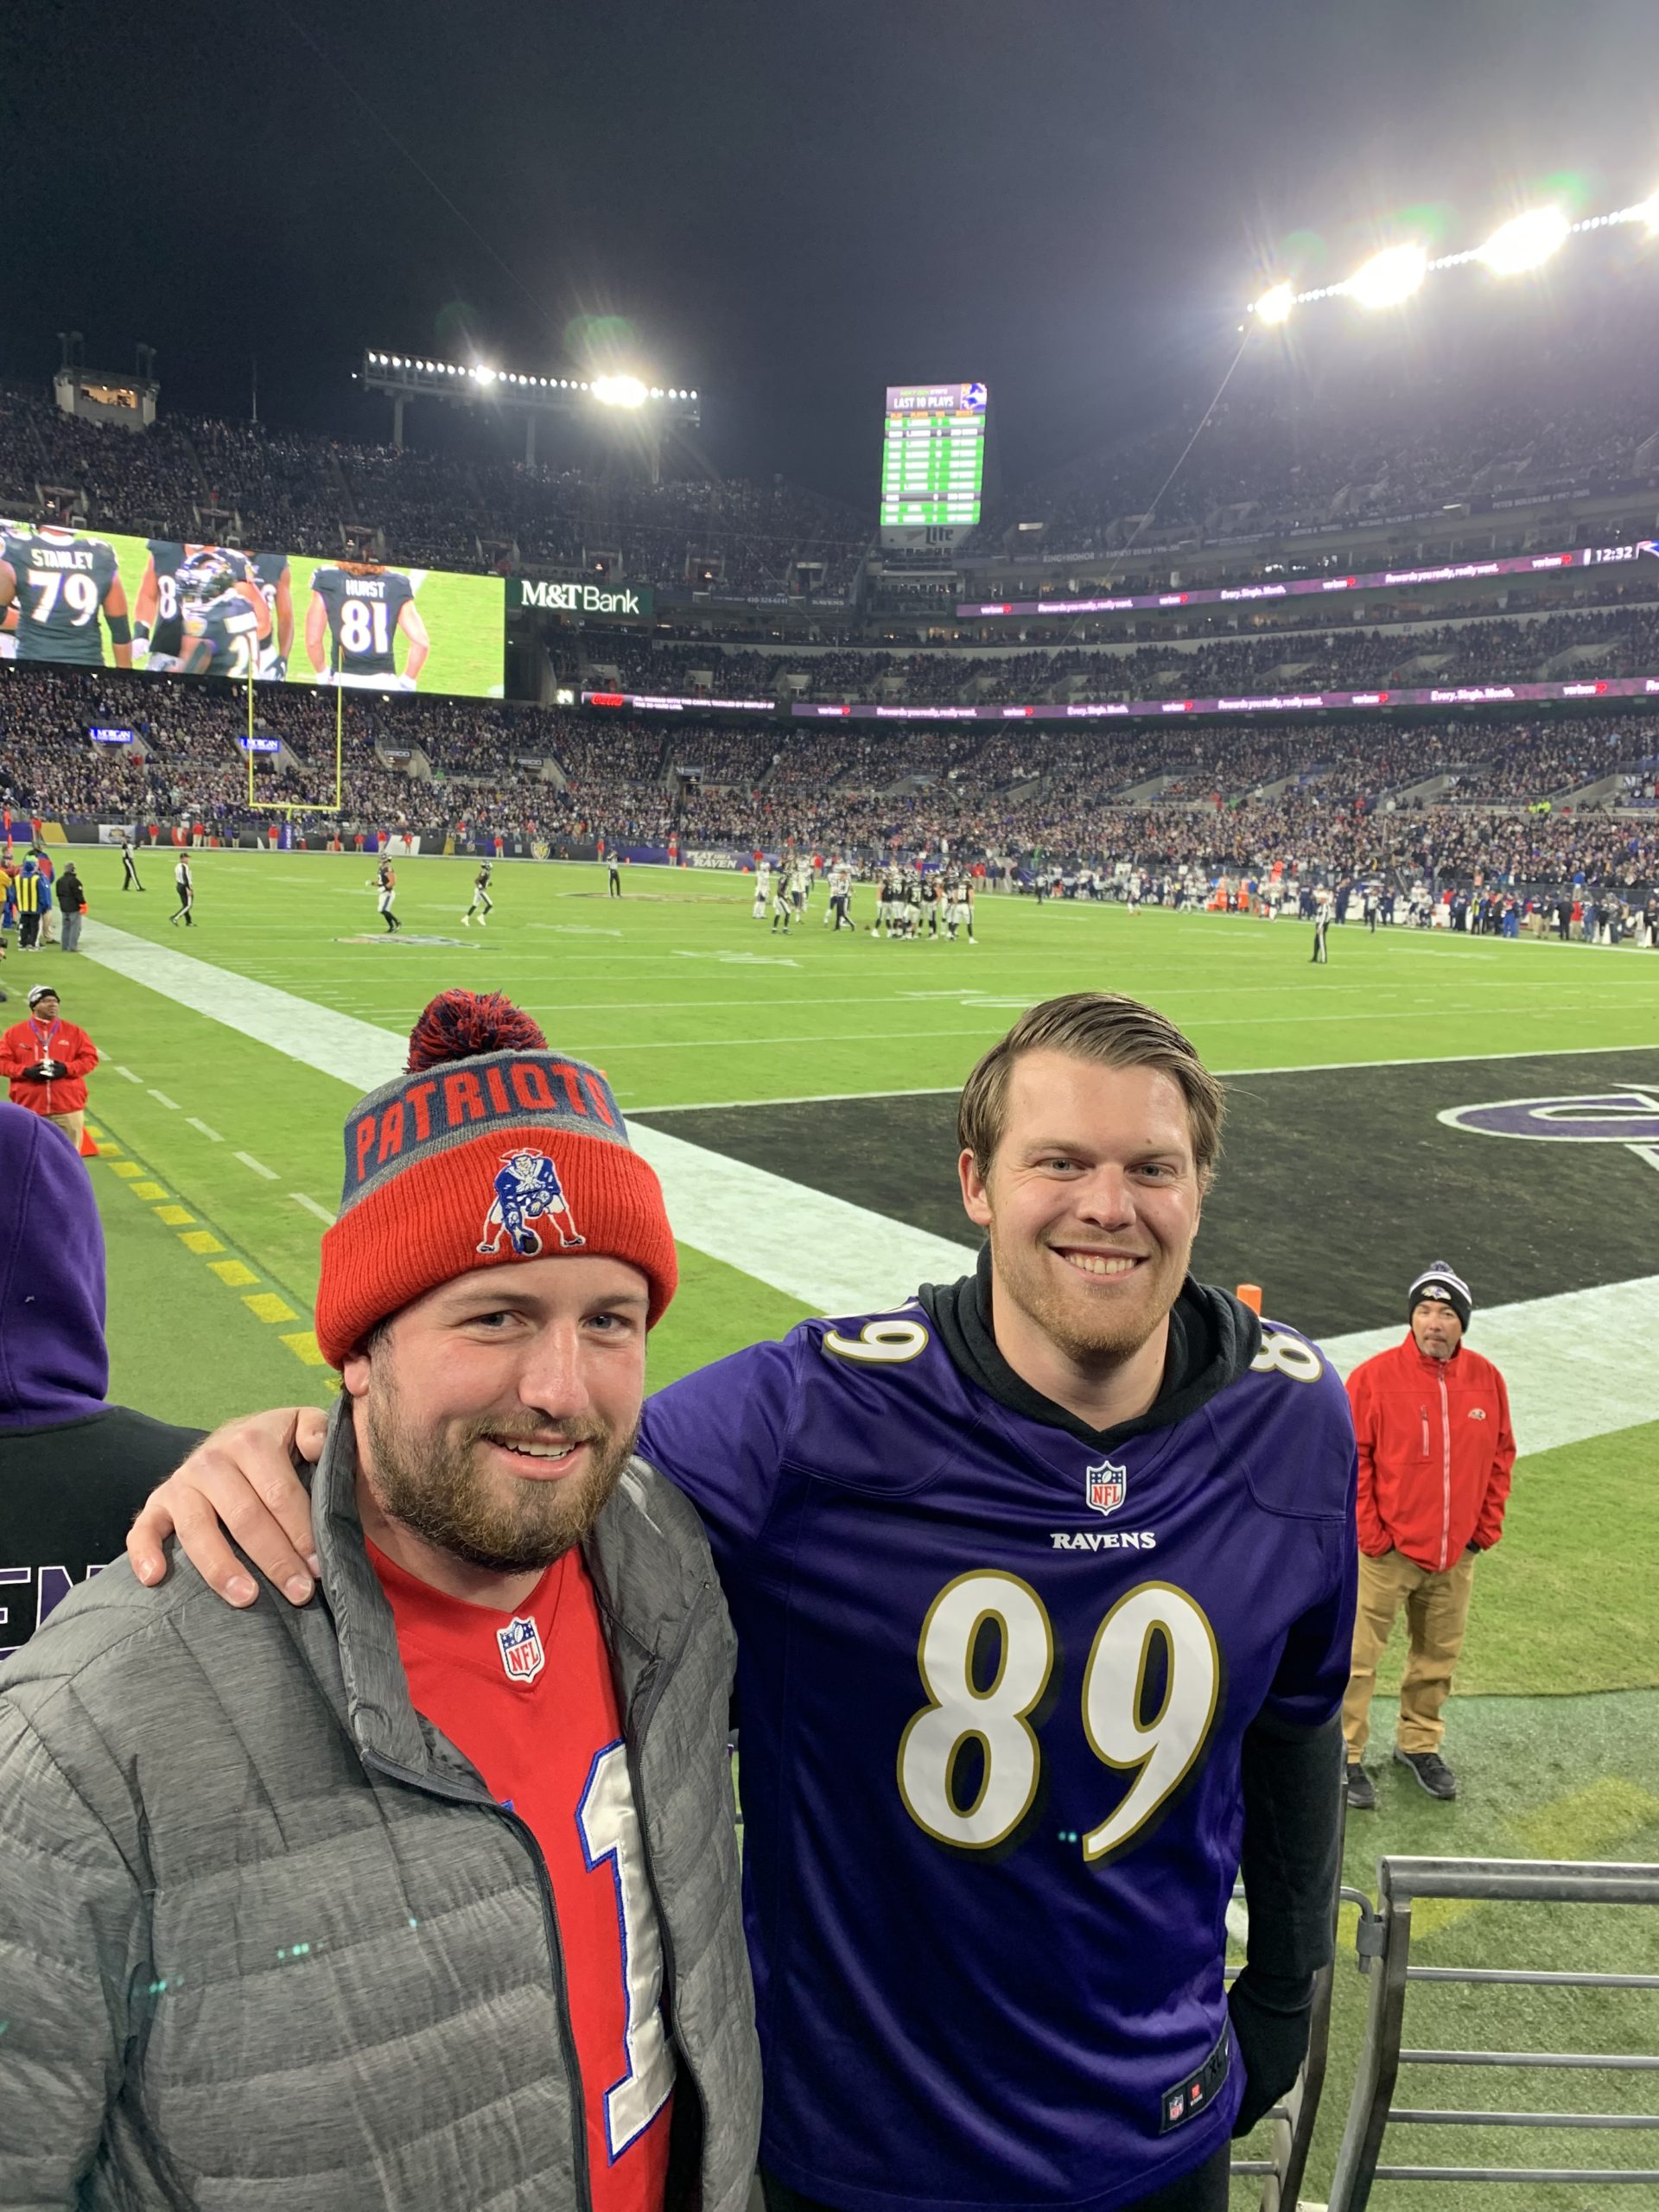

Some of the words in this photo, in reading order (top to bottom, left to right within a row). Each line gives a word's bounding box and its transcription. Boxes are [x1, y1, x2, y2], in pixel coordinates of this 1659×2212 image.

[893, 397, 914, 408] LAST
[917, 397, 926, 408] 10
[928, 396, 954, 407] PLAYS
[925, 526, 954, 544] Lite
[1532, 556, 1562, 569] verizon
[1596, 546, 1632, 562] 12:32
[1323, 579, 1347, 590] verizon
[1385, 571, 1417, 583] Rewards
[28, 567, 98, 626] 79
[346, 579, 385, 599] HURST
[521, 580, 582, 610] M&T
[583, 586, 639, 614] Bank
[340, 599, 388, 653] 81
[1352, 694, 1379, 704] verizon
[1563, 684, 1596, 696] verizon
[97, 729, 131, 738] MORGAN
[686, 850, 713, 860] PLAY
[693, 858, 737, 869] RAVEN
[356, 1062, 614, 1182] PATRIOTS
[823, 1319, 929, 1363] 9
[1249, 1329, 1324, 1383] 8
[1092, 1485, 1120, 1506] NFL
[1051, 1531, 1157, 1553] RAVENS
[508, 1641, 539, 1672] NFL
[896, 1568, 1220, 1862] 89
